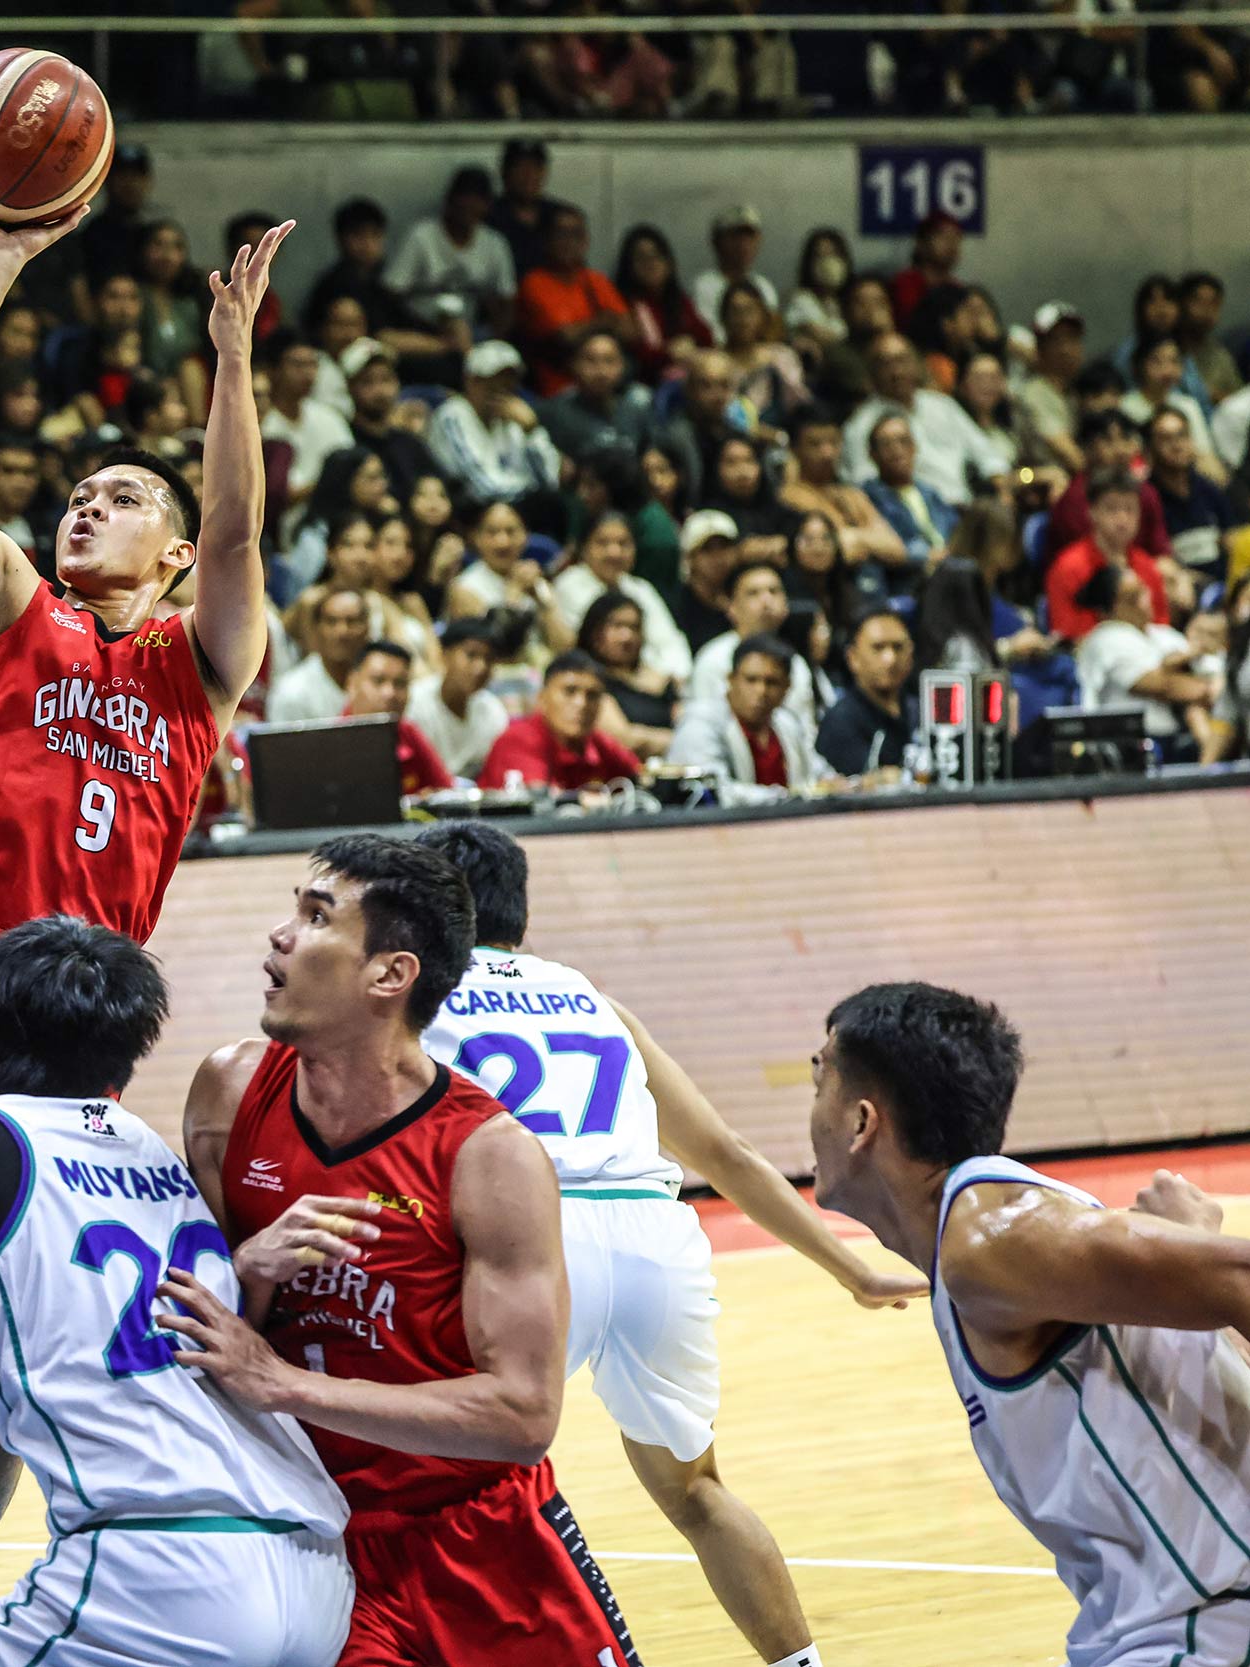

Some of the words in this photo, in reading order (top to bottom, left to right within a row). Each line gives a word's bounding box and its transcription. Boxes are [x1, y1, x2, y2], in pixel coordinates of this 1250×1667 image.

[868, 160, 975, 219] 116
[72, 662, 146, 694] BANGAY
[46, 726, 88, 760] SAN
[91, 740, 161, 783] MIGUEL
[74, 778, 117, 853] 9
[446, 989, 597, 1015] CARALIPIO
[452, 1031, 631, 1137] 27
[241, 1178, 284, 1192] BALANCE
[248, 1171, 281, 1184] WORLD
[290, 1262, 396, 1332] EBRA
